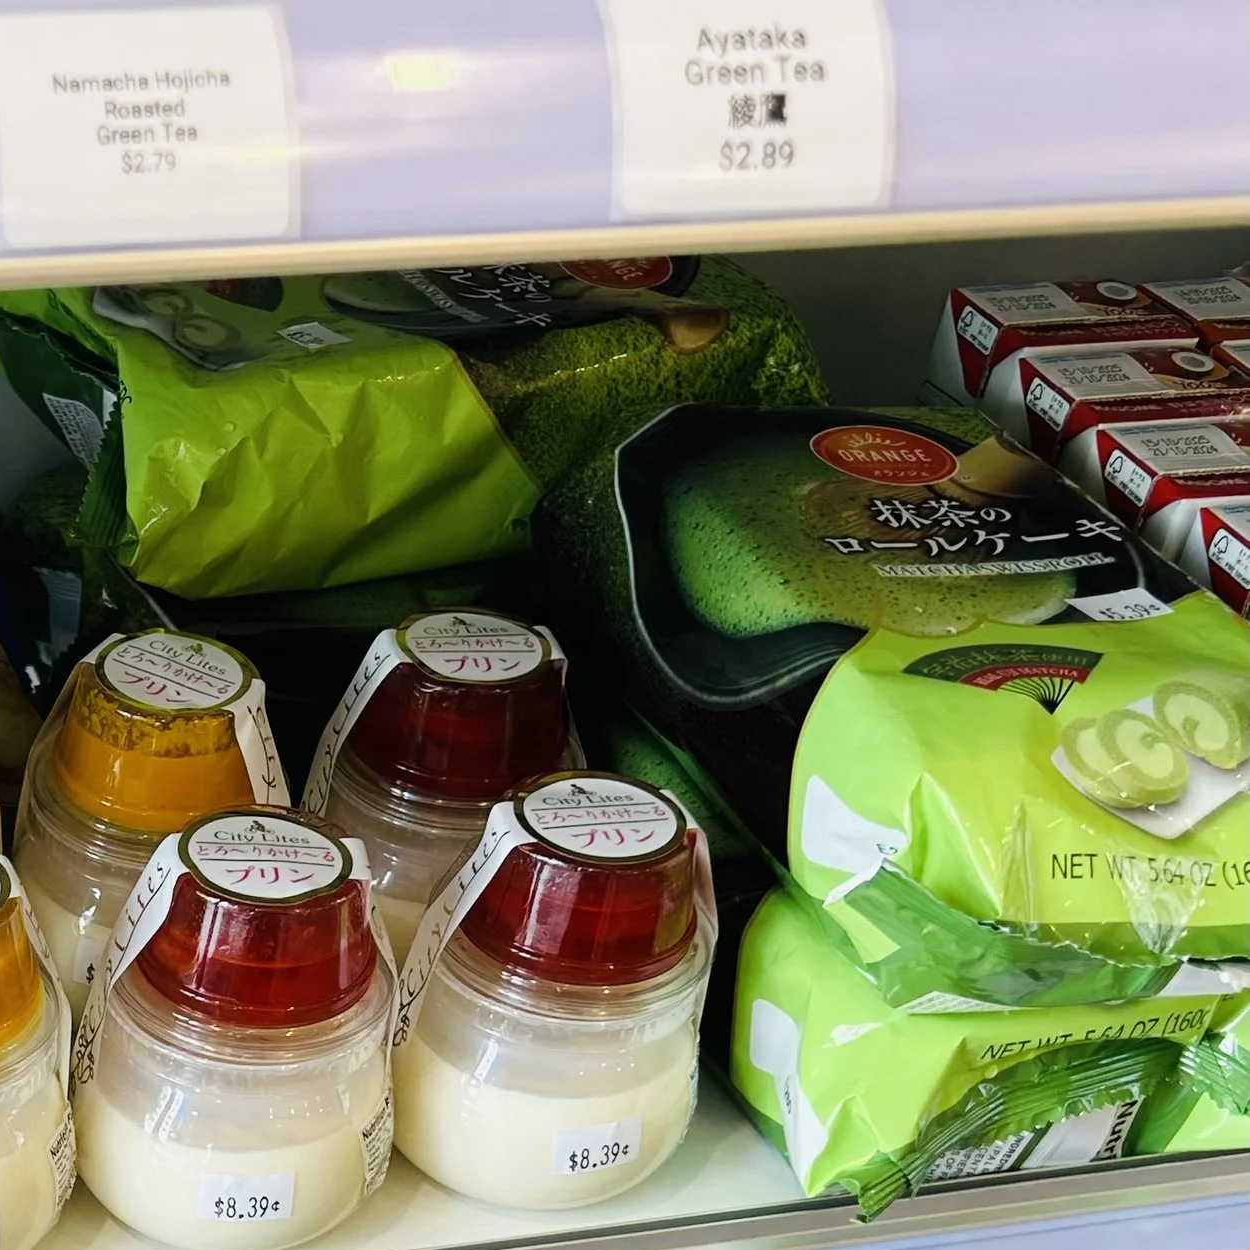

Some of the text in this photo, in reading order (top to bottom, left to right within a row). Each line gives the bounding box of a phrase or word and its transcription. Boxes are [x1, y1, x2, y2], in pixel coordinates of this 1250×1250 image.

[697, 22, 807, 58] Ayataka
[52, 69, 231, 94] Namacha Hojicha
[685, 56, 827, 85] Green Tea
[104, 99, 185, 119] Roasted
[97, 122, 198, 146] Green Tea
[121, 151, 176, 175] $2.79
[718, 140, 795, 171] $2.89
[837, 448, 931, 463] ORANGE
[870, 499, 1013, 529] 抹茶の
[824, 518, 1123, 556] ロールケーキ
[423, 625, 509, 636] City Lites
[150, 640, 227, 676] City Lites
[444, 655, 520, 673] プリン
[117, 671, 193, 702] プリン
[542, 794, 634, 806] City Lites
[213, 830, 310, 844] City Lites
[571, 828, 655, 848] プリン
[225, 865, 315, 885] プリン
[1052, 853, 1217, 887] NET OZ
[981, 1040, 1032, 1060] NET
[570, 1142, 635, 1171] $8.39¢
[214, 1196, 281, 1221] $8.39¢
